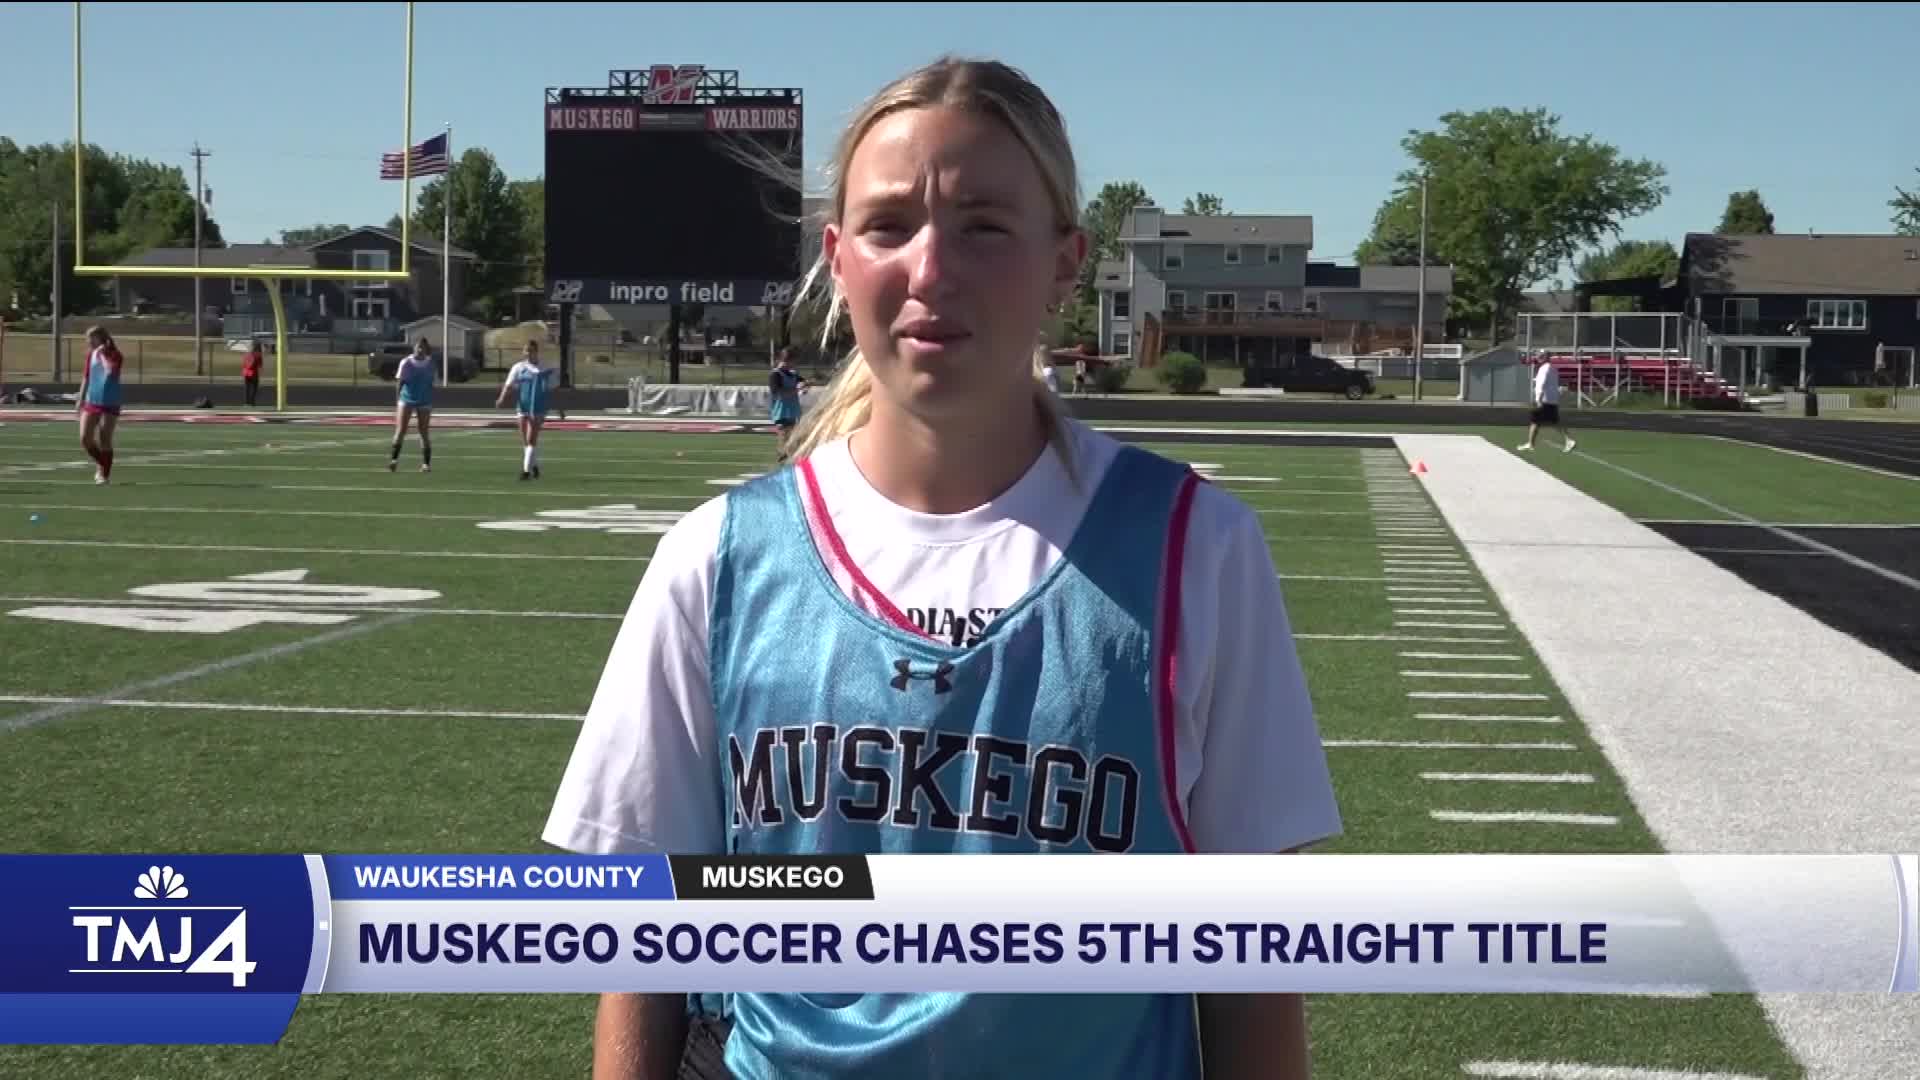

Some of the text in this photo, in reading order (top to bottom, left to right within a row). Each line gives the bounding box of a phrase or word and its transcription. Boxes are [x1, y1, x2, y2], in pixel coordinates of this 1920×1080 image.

[550, 108, 798, 129] MUSKEGO WARRIORS
[610, 281, 669, 304] inpro
[680, 282, 735, 303] field
[728, 722, 1140, 854] MUSKEGO
